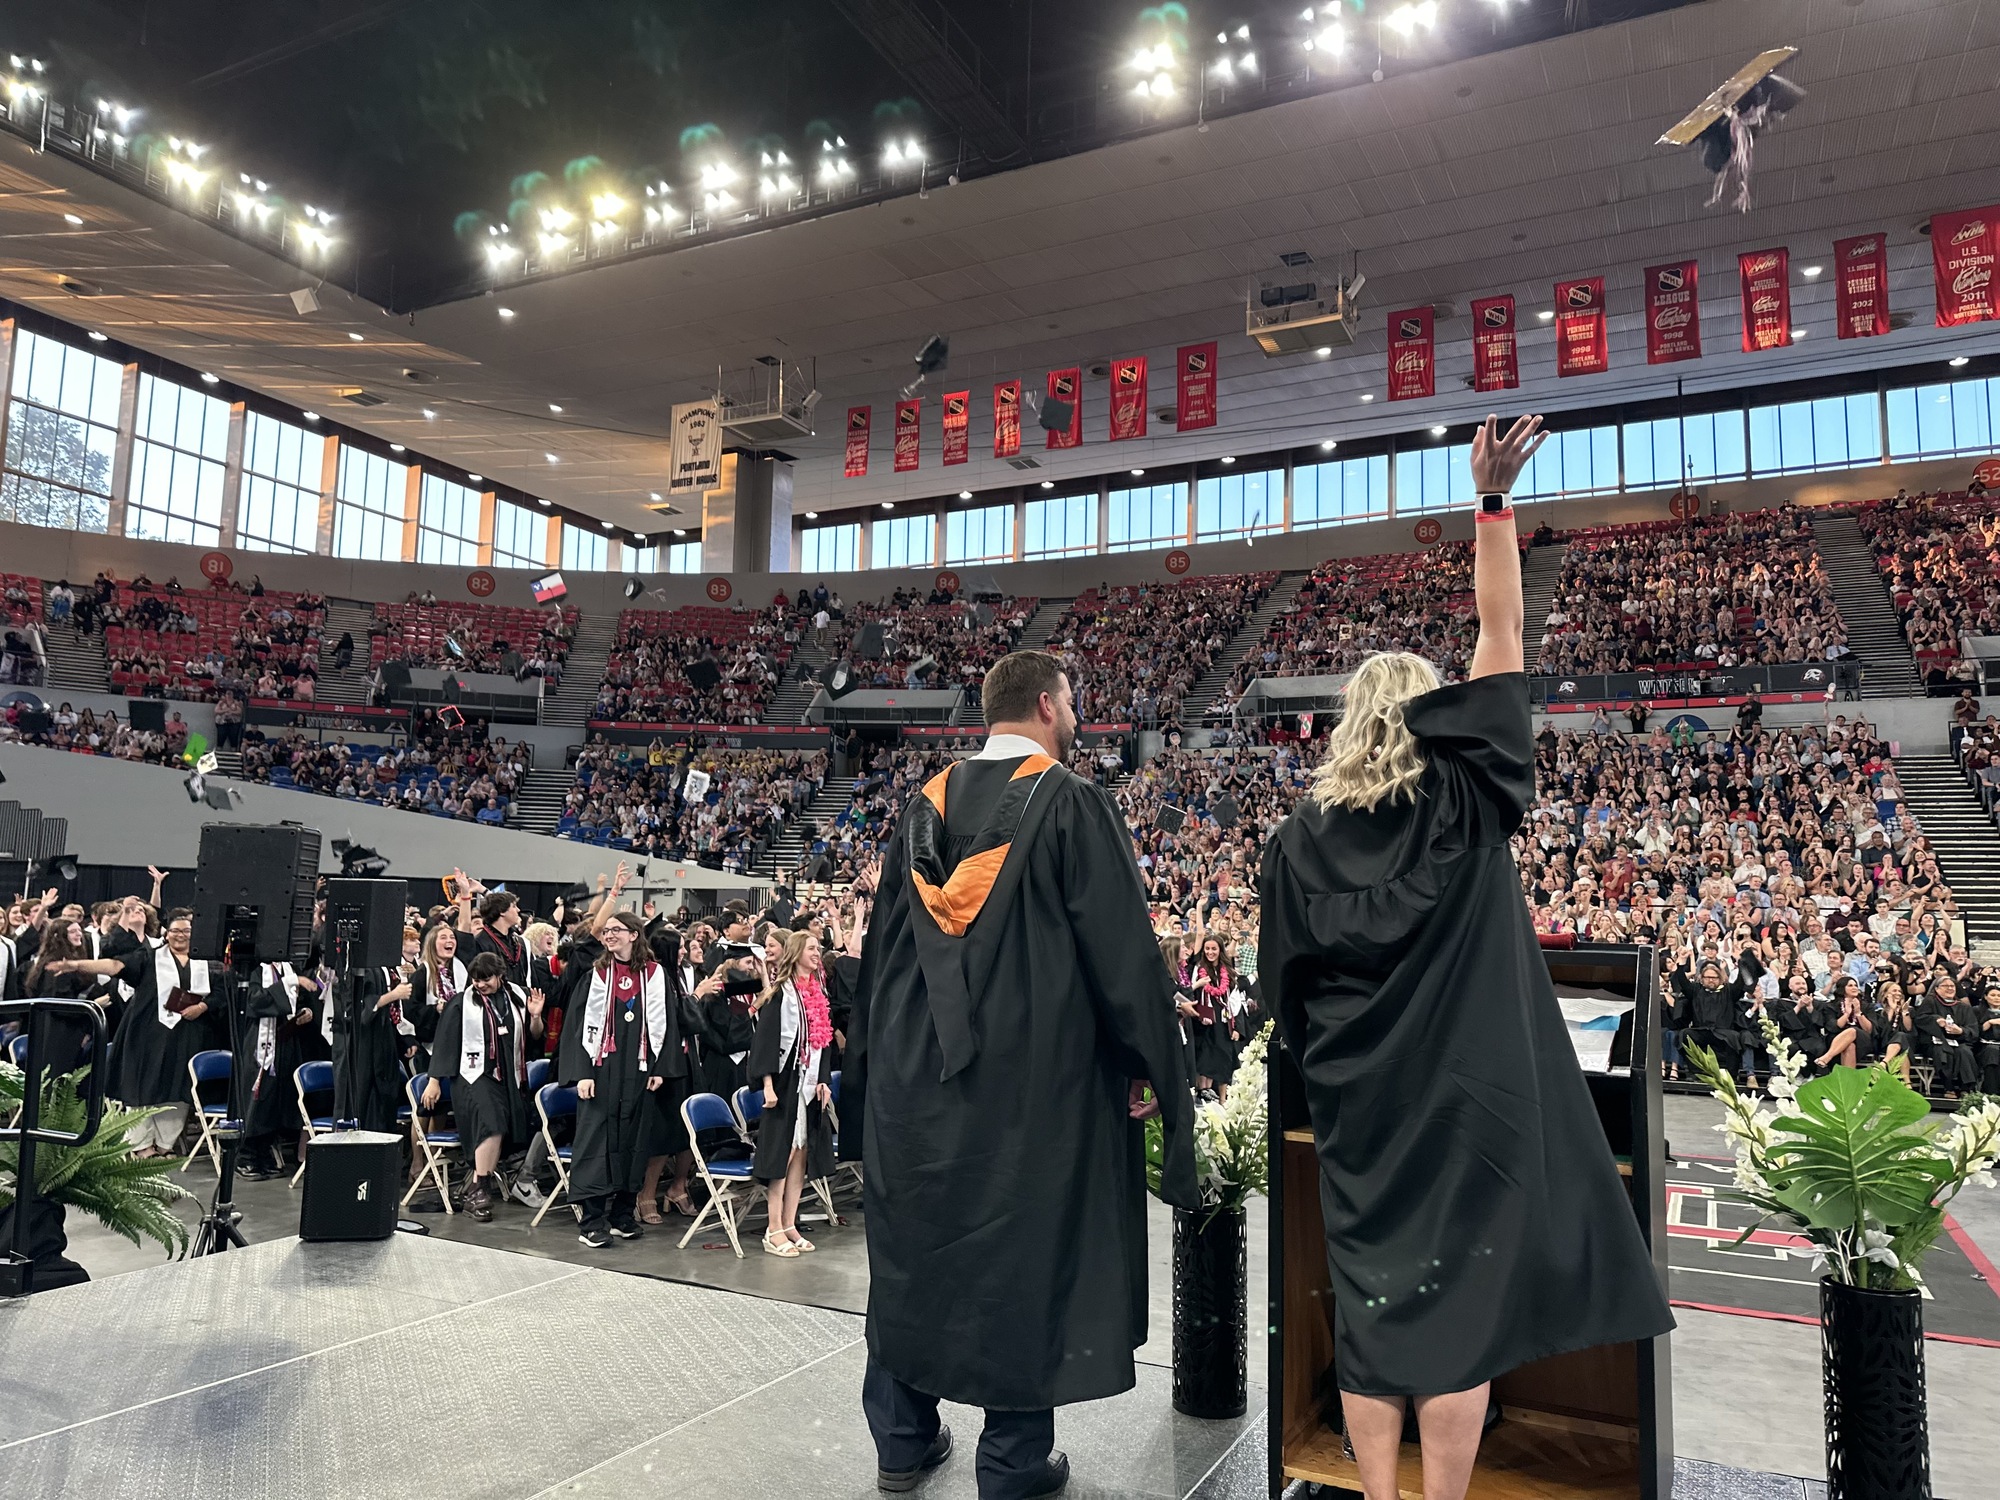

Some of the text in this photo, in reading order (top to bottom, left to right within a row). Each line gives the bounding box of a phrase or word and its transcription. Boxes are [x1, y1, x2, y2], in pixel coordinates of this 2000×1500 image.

[1962, 246, 1979, 256] U.S.
[1949, 255, 1994, 270] DIVISION
[1662, 274, 1681, 286] WHL
[1572, 290, 1589, 302] WHL
[1654, 291, 1690, 306] LEAGUE
[1961, 291, 1986, 302] 2011
[1852, 300, 1873, 309] 2002
[1959, 302, 1988, 312] PORTLAND
[1488, 310, 1504, 322] WHL
[1559, 308, 1600, 320] WEST DIVISION
[1404, 322, 1418, 334] WHL
[1567, 324, 1594, 334] PENNANT
[1568, 332, 1594, 342] WINNERS
[1663, 331, 1684, 340] 1998
[1572, 346, 1591, 354] 1998
[1660, 340, 1688, 350] PORTLAND
[1654, 347, 1674, 356] WINTER
[680, 408, 715, 424] CHAMPIONS
[680, 460, 710, 472] PORTLAND
[1980, 467, 2000, 482] 52
[1419, 526, 1436, 538] 86
[208, 560, 224, 573] 81
[1170, 557, 1186, 568] 85
[472, 578, 489, 590] 82
[940, 577, 956, 589] 84
[710, 584, 726, 596] 83
[588, 1026, 598, 1044] T
[466, 1052, 479, 1068] T
